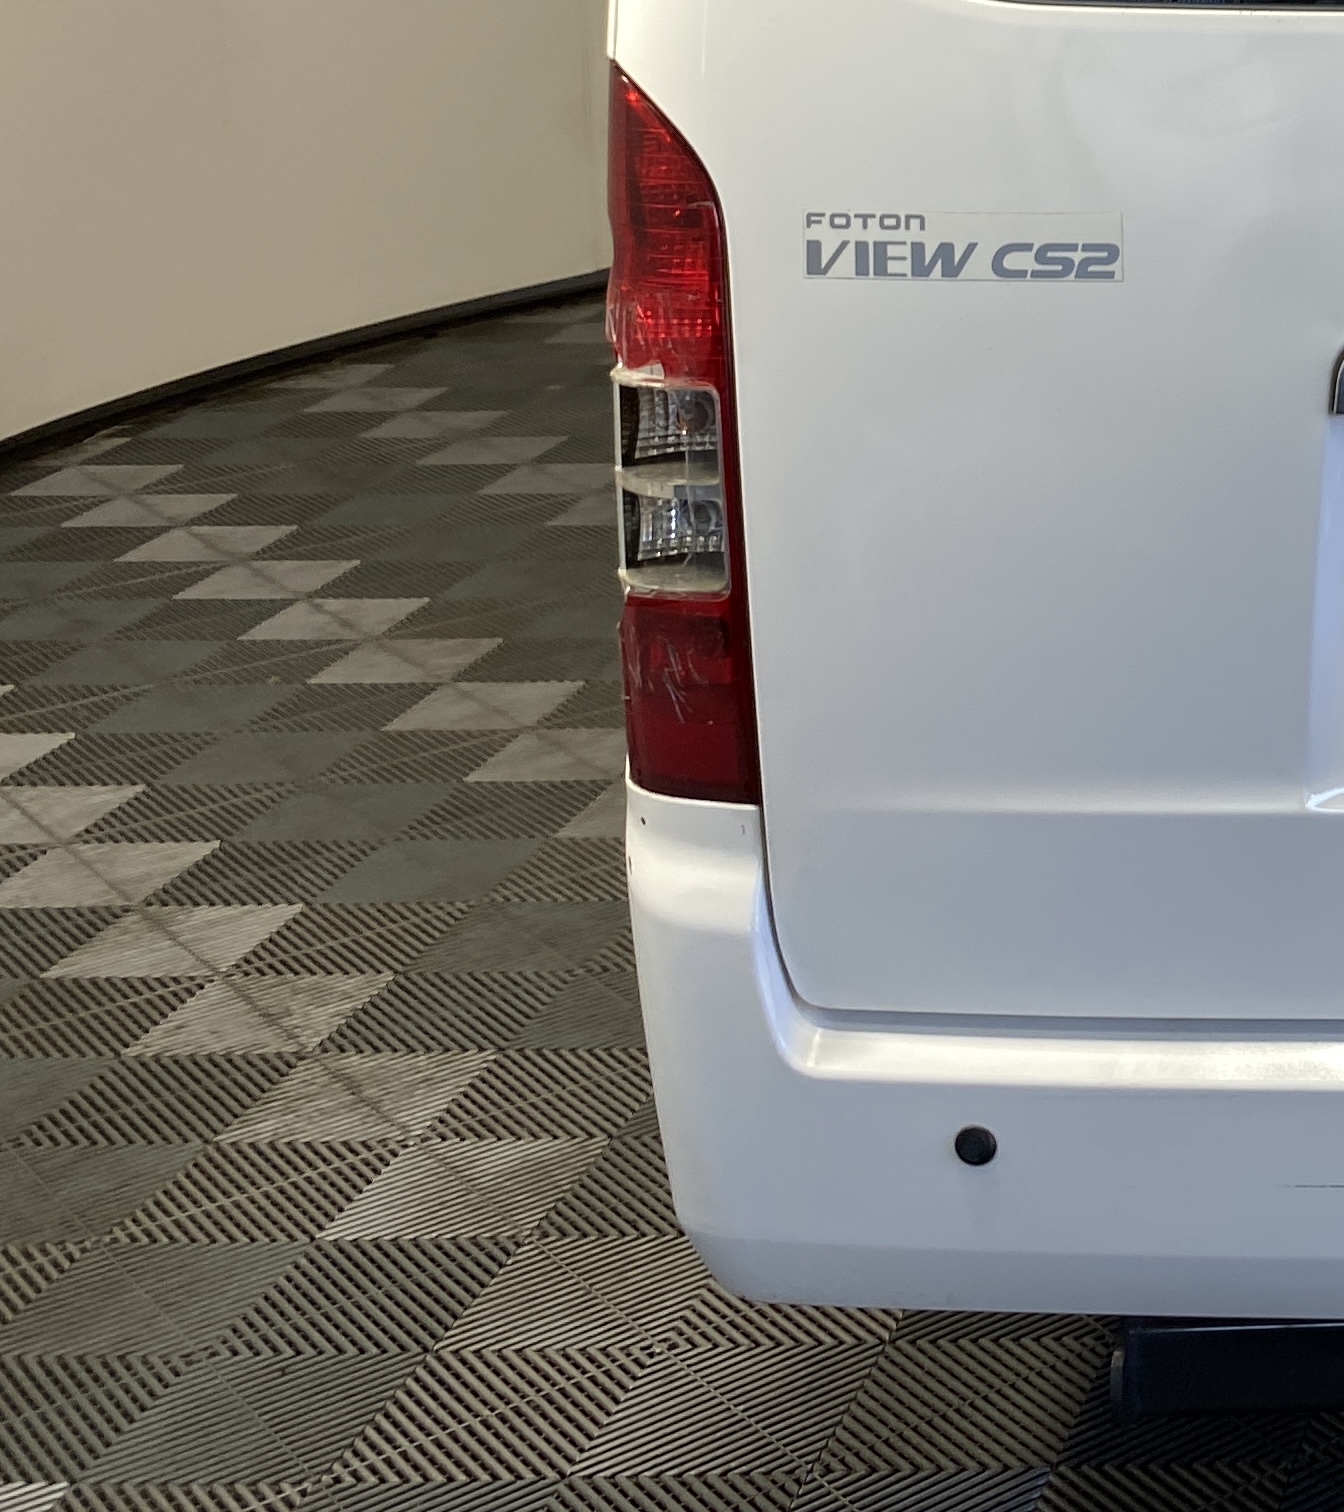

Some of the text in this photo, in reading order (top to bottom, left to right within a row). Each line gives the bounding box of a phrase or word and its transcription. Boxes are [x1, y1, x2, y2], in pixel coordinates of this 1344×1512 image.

[805, 212, 926, 231] FOTON
[805, 239, 1121, 280] VIEW CS2
